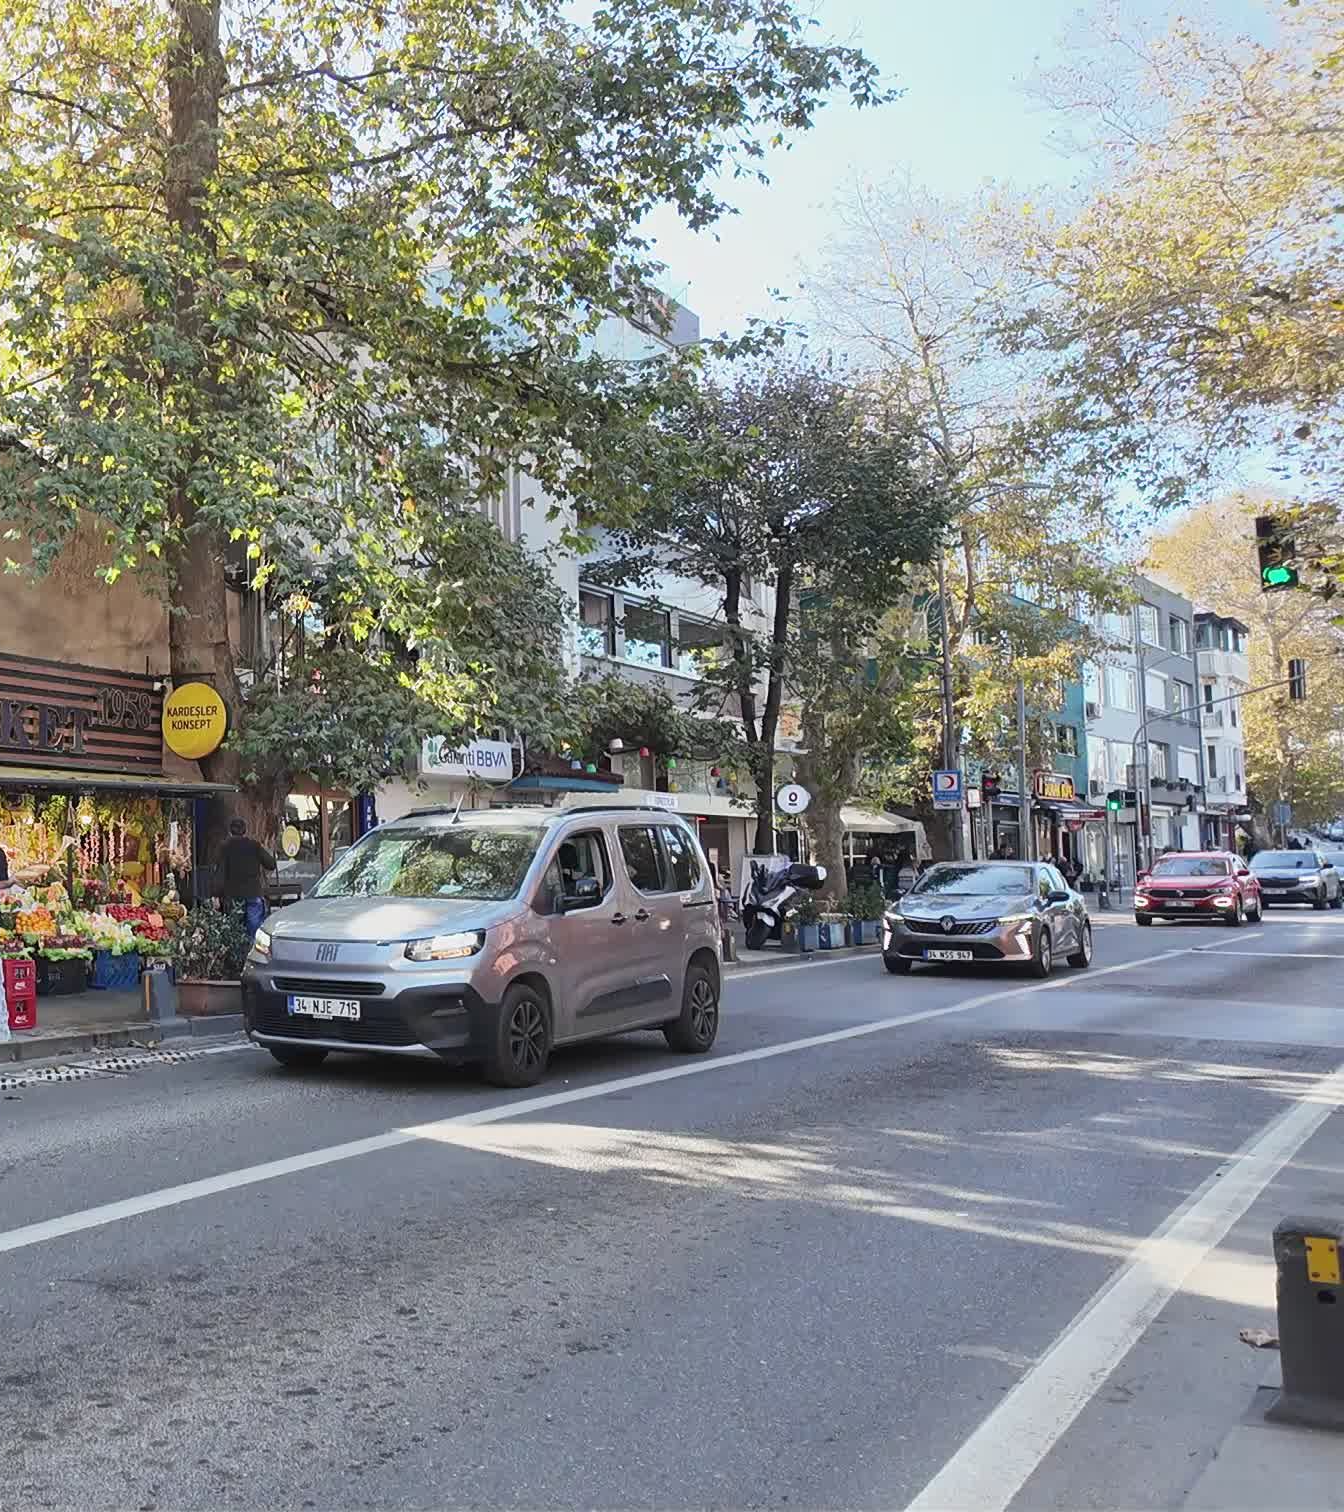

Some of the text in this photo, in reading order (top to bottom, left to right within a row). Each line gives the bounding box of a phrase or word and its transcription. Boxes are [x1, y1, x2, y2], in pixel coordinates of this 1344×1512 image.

[97, 687, 152, 729] 1958
[167, 705, 218, 719] KARDEŞLER
[172, 719, 212, 731] KONSEPT
[477, 750, 507, 767] BBVA
[316, 943, 341, 962] FIAT
[296, 998, 358, 1016] 34 NJE 715
